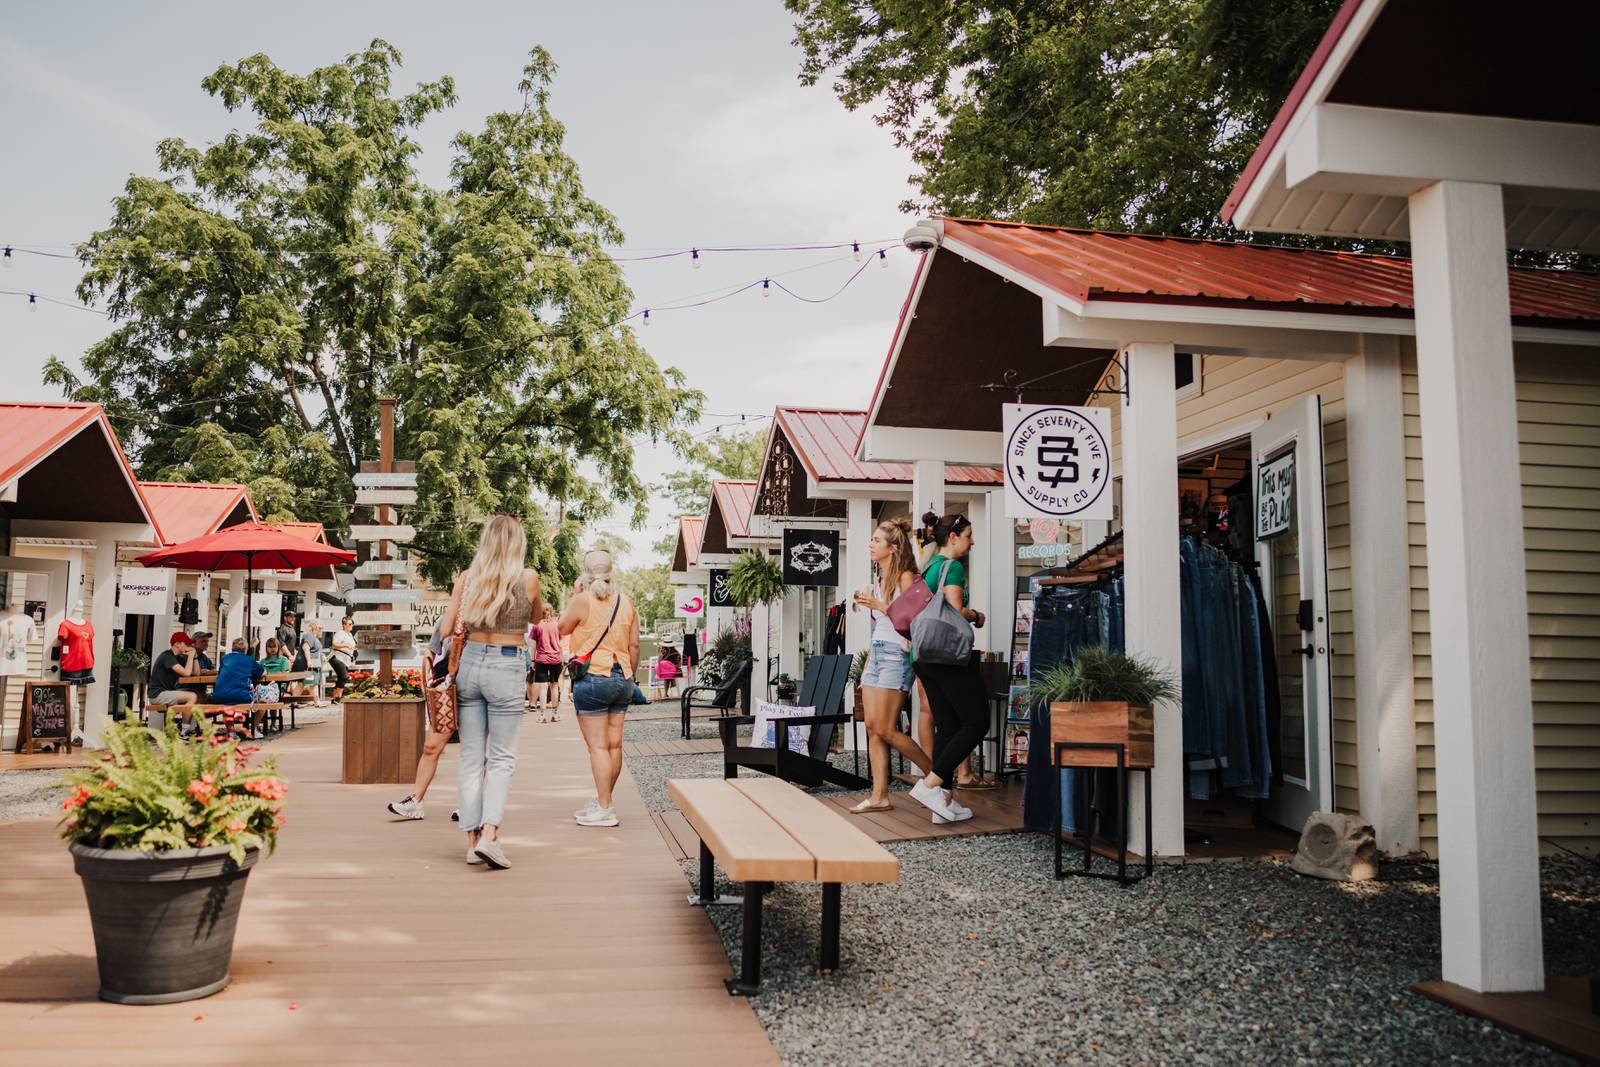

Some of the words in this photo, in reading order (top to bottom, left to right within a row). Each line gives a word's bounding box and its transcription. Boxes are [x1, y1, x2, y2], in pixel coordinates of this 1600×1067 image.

[1015, 425, 1036, 457] SINCE
[1037, 416, 1086, 434] SEVENTY
[1085, 434, 1102, 460] FIVE
[1261, 468, 1276, 497] THIS
[1027, 486, 1069, 508] SUPPLY
[1073, 489, 1088, 504] CO
[1018, 544, 1072, 559] RECORDS
[32, 703, 65, 717] VINTAGE
[36, 716, 65, 730] STORE
